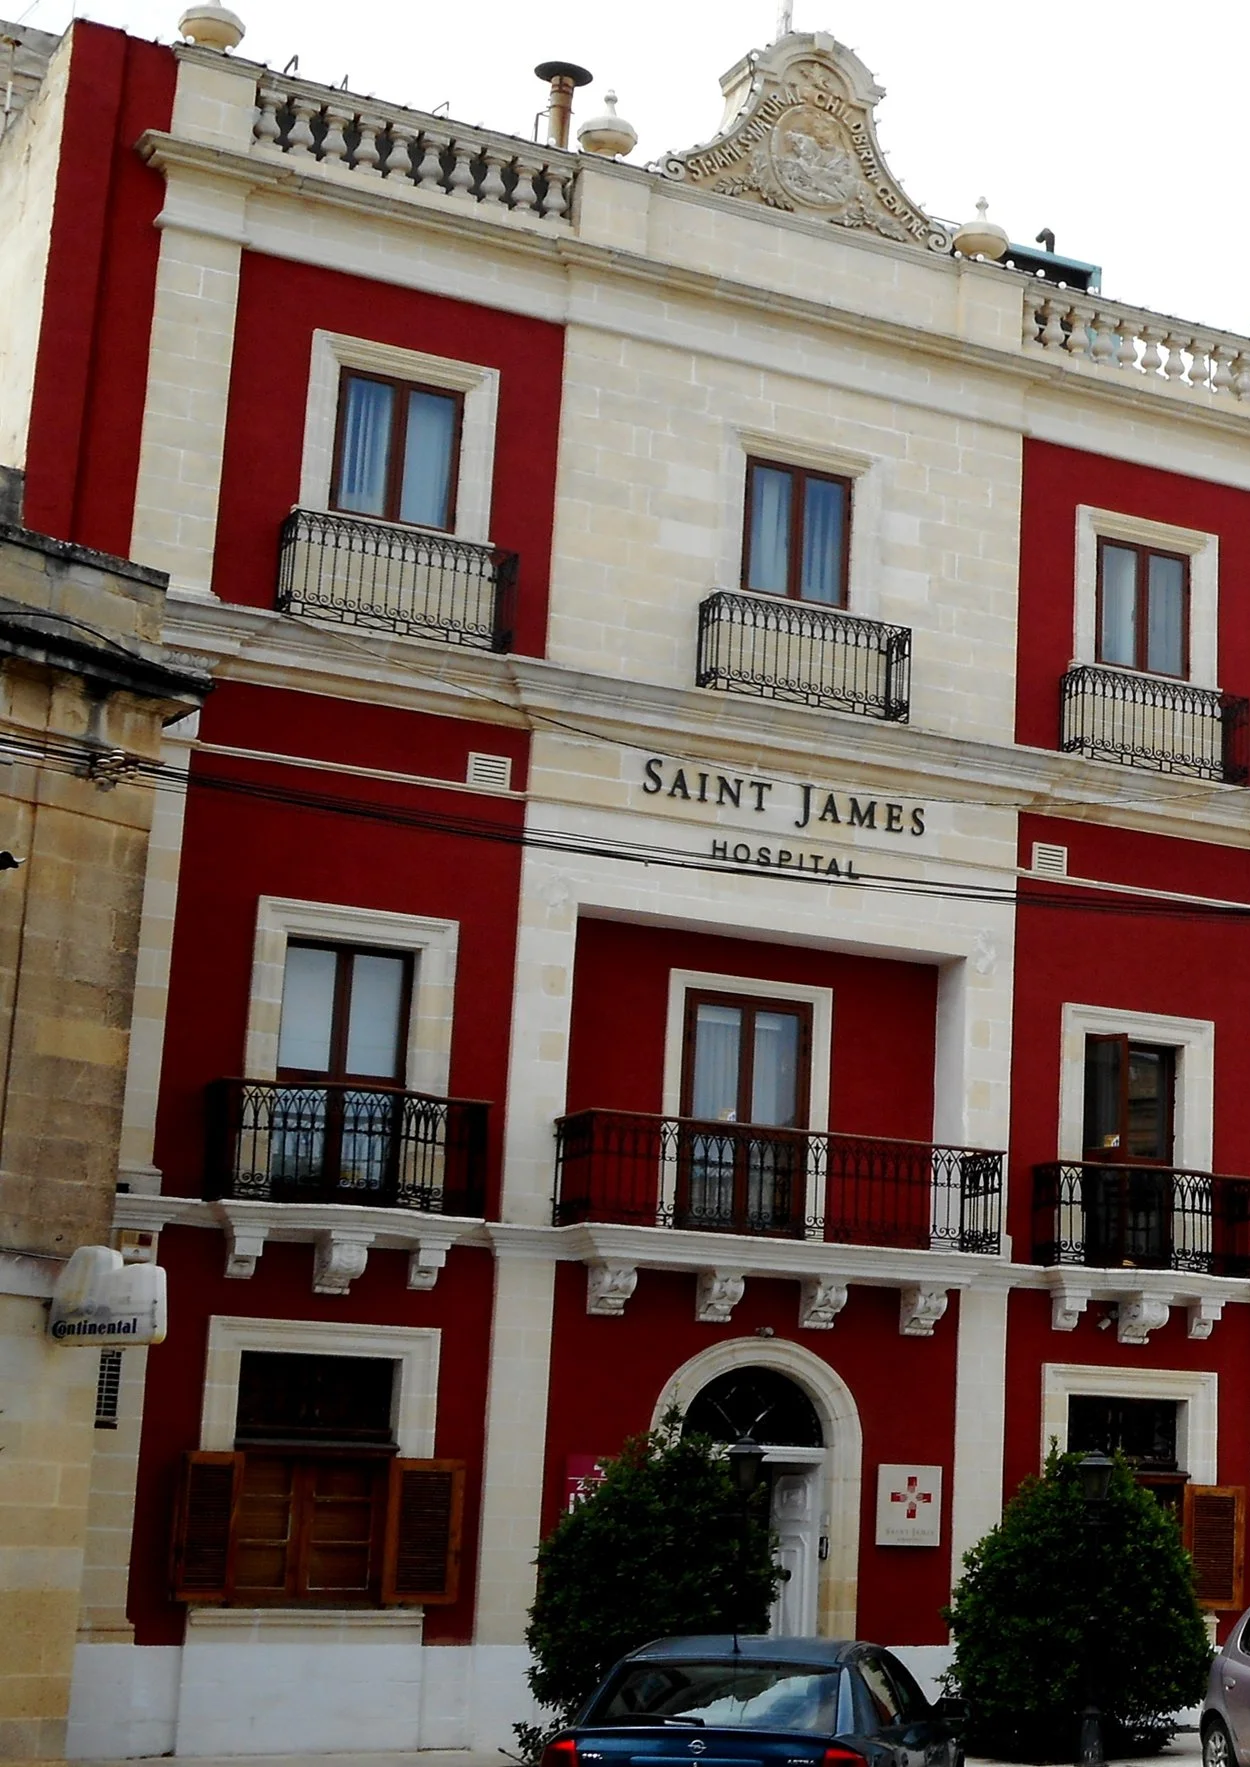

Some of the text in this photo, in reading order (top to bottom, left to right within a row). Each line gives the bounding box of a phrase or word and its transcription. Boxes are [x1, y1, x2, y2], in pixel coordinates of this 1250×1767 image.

[876, 185, 929, 240] CENTRE
[642, 758, 926, 837] SAINT JAMES
[711, 838, 861, 880] HOSPITAL
[51, 1317, 138, 1339] Continental
